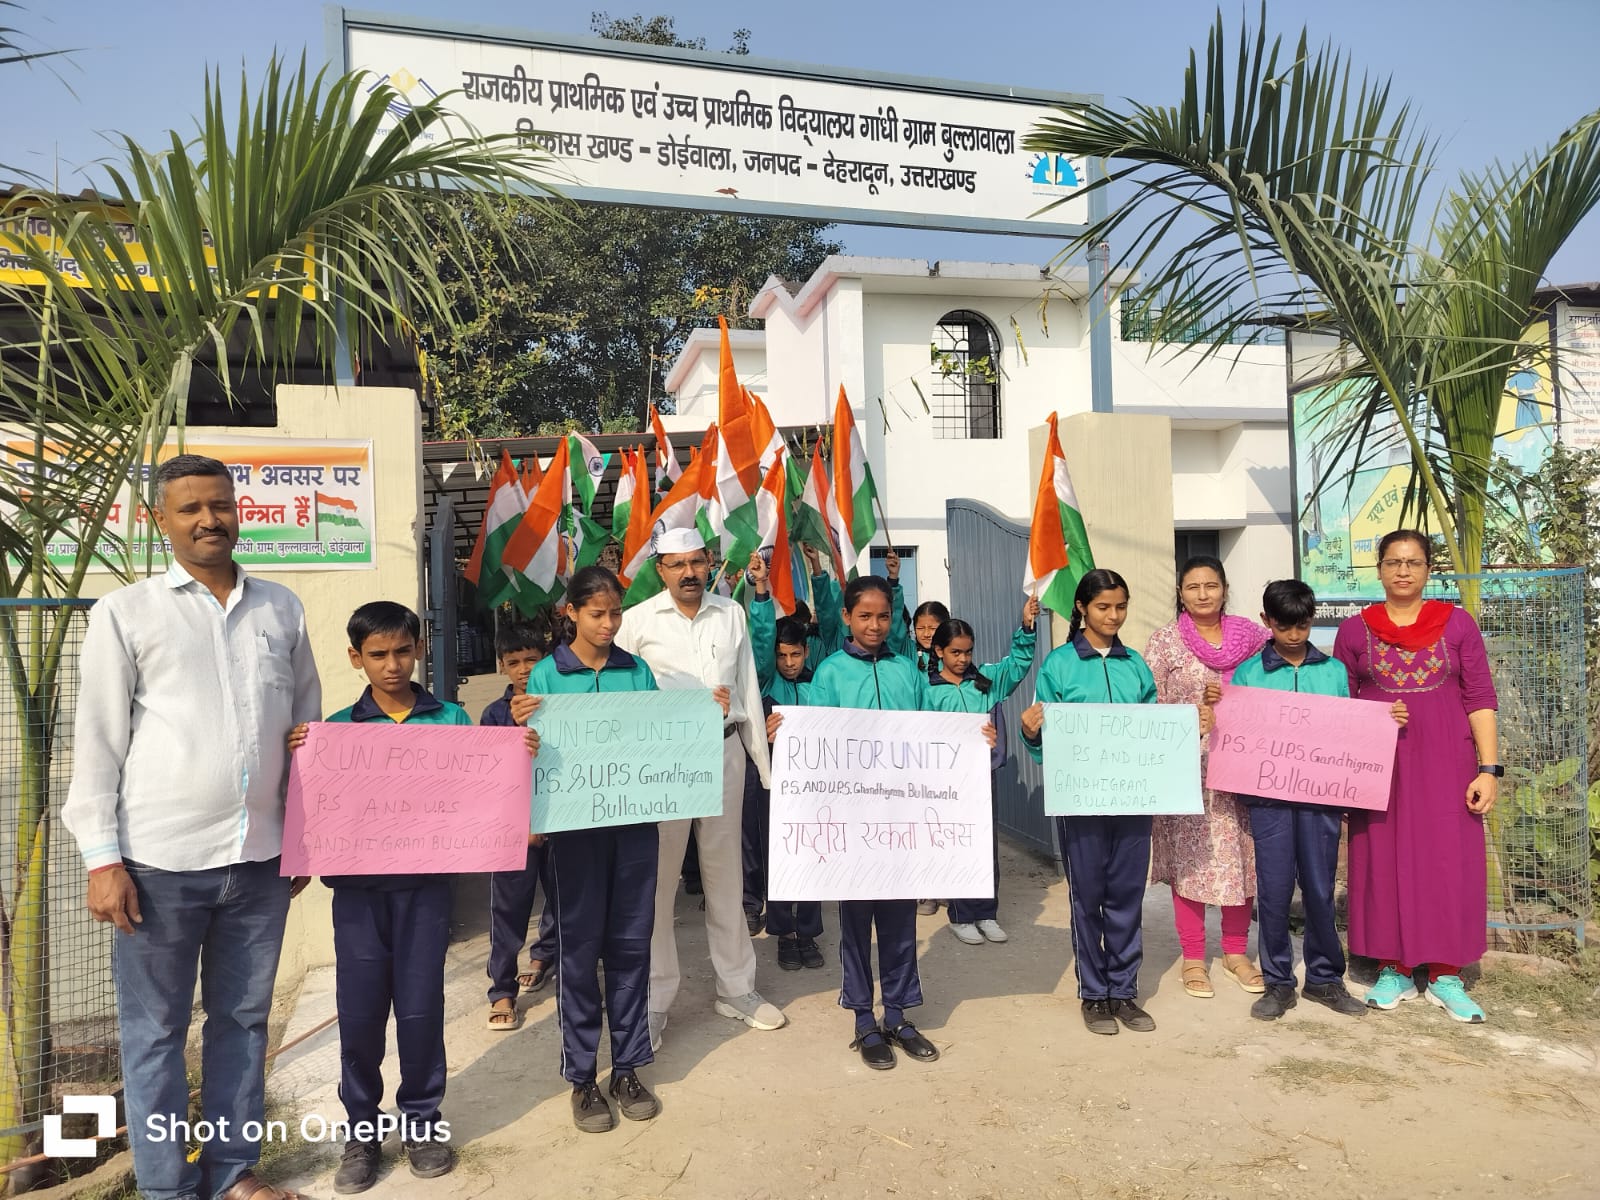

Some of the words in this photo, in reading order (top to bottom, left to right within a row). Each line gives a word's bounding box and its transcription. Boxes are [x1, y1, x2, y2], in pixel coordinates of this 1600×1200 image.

[462, 64, 543, 106] राजकीय
[548, 72, 625, 114] प्राथमिक
[631, 81, 660, 119] एवं
[662, 92, 698, 122] उच्च
[702, 89, 772, 130] प्राथमिक
[859, 106, 899, 143] गांधी
[902, 118, 936, 150] ग्राम
[940, 123, 1015, 162] बुल्लावाला
[587, 133, 633, 163] खण्ड
[657, 134, 737, 174] डोईवाला,
[743, 150, 801, 176] जनपद
[823, 150, 895, 195] देहरादून,
[900, 164, 977, 193] उत्तराखण्ड
[261, 465, 324, 486] अवसर
[333, 466, 361, 487] पर
[294, 495, 311, 528] हैं
[257, 541, 274, 553] ग्राम
[328, 537, 365, 556] डोईवाला
[1279, 705, 1312, 727] FOR
[585, 719, 624, 745] FOR
[636, 720, 706, 741] UNITY
[1053, 709, 1089, 735] RUN
[1100, 714, 1137, 740] FOR
[1139, 719, 1193, 751] UNITY
[308, 736, 374, 772] RUN
[385, 746, 430, 772] FOR
[435, 752, 503, 775] UNITY
[788, 736, 838, 771] RUN
[846, 738, 888, 770] FOR
[890, 741, 962, 769] UNITY
[1100, 749, 1131, 765] AND
[1309, 747, 1384, 774] Gandhigram
[638, 762, 713, 789] Gandhigram
[1054, 769, 1149, 793] GANDHIGRAM
[1256, 759, 1359, 802] Bullawala
[802, 780, 827, 793] AND
[907, 782, 959, 800] Bullawala
[1072, 794, 1158, 809] BULLAWALA
[363, 798, 413, 817] AND
[424, 800, 461, 815] U.P.S
[592, 792, 679, 822] Bullawala
[923, 807, 976, 850] दिवस
[431, 834, 524, 851] BULLAWALA
